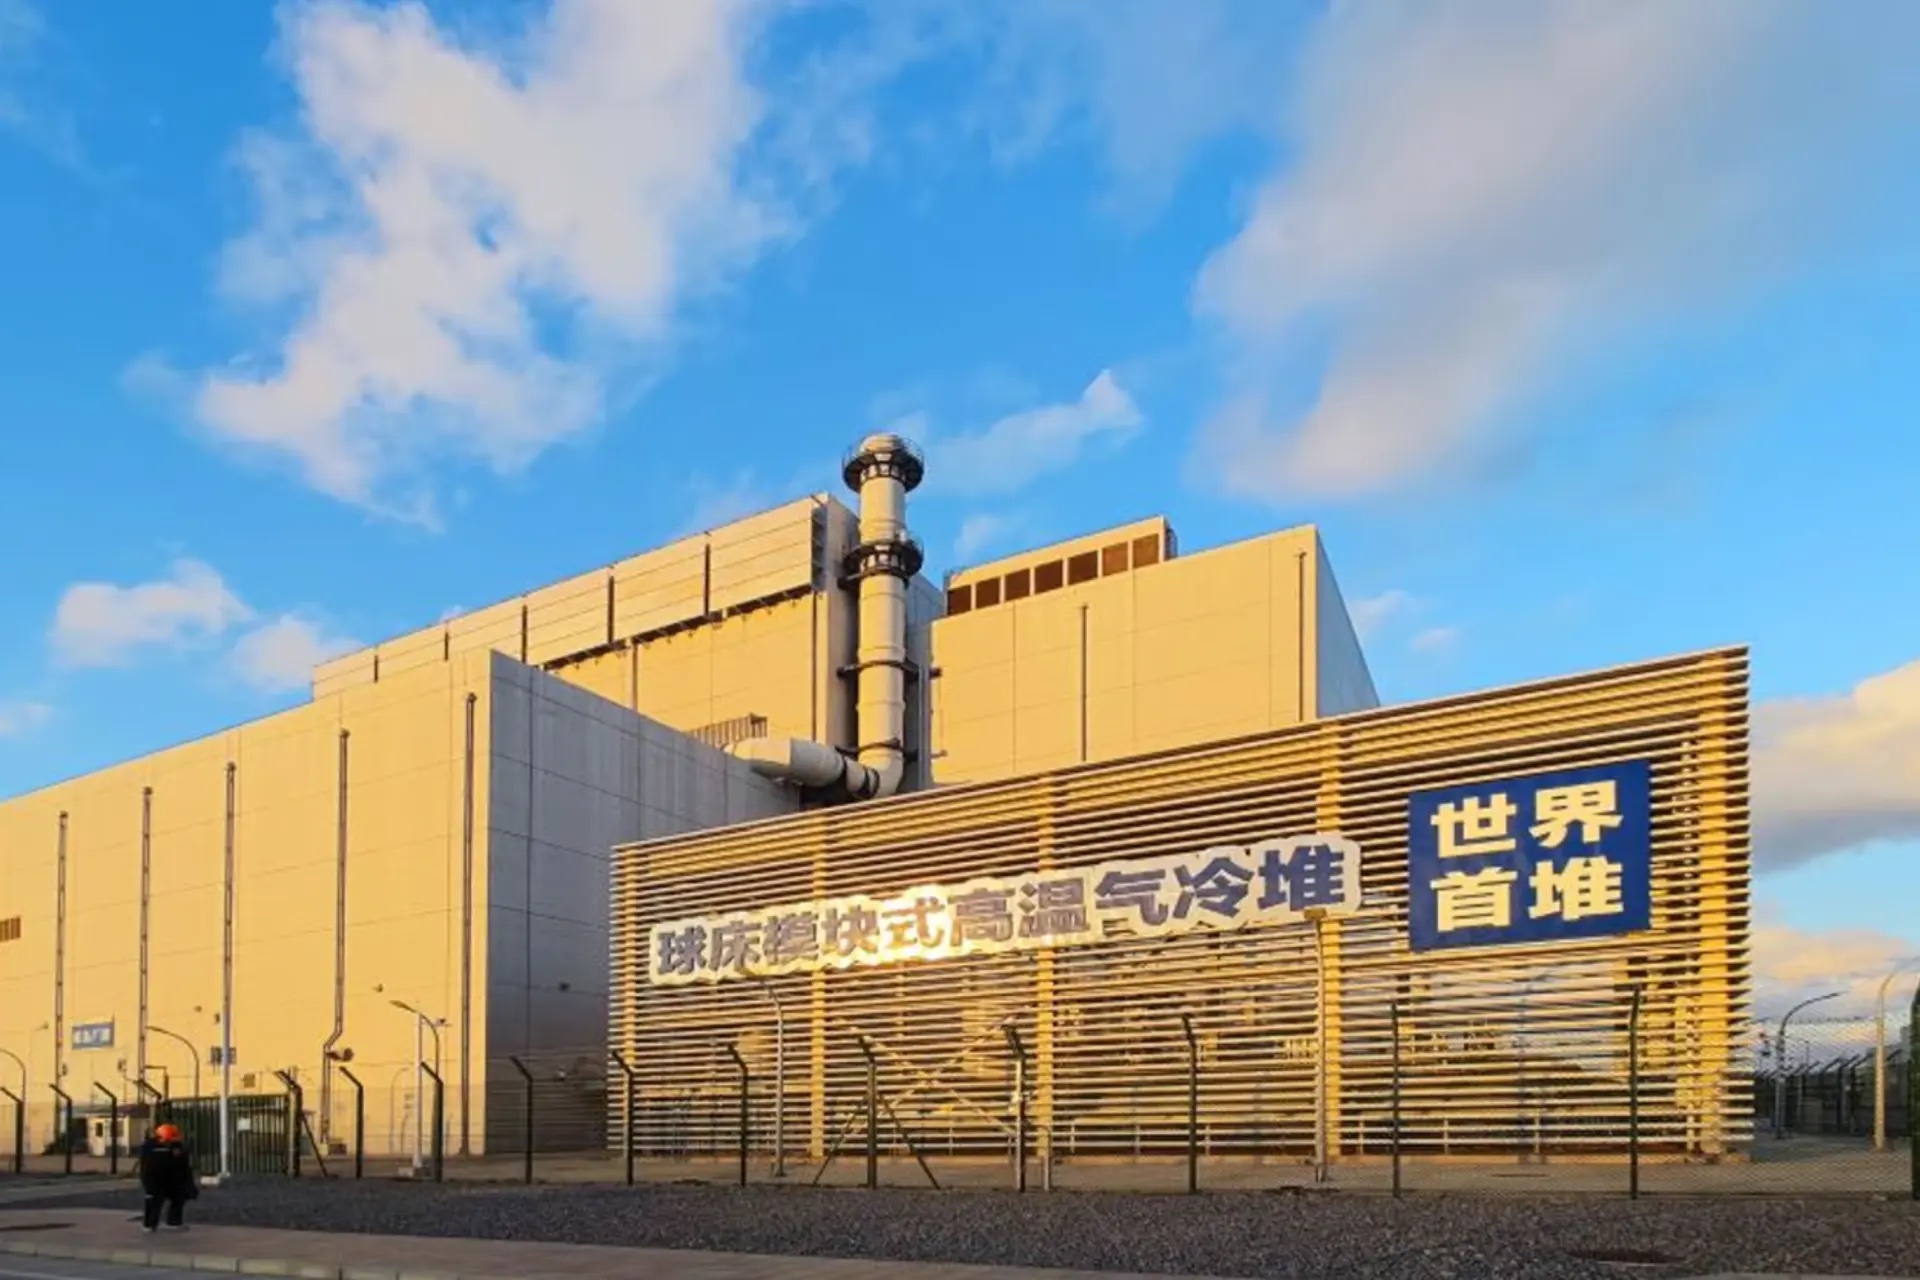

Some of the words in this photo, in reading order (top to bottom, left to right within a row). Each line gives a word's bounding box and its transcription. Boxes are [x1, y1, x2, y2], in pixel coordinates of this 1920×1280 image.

[1430, 780, 1624, 858] 世界
[658, 844, 1345, 975] 球床模块式高温气冷堆
[1430, 855, 1624, 932] 首堆
